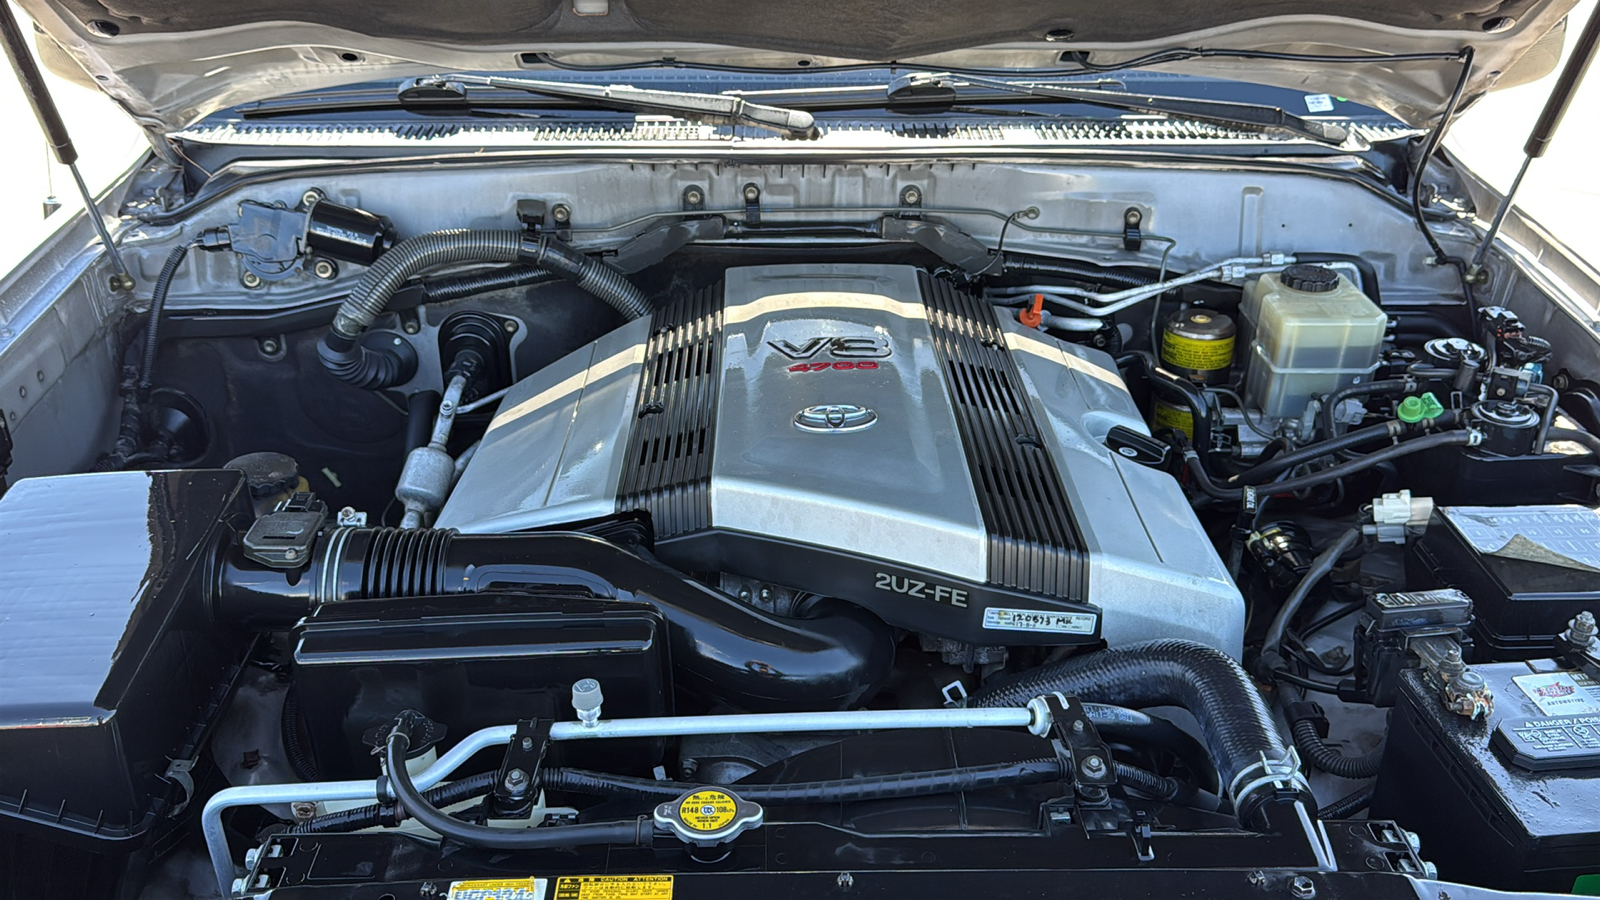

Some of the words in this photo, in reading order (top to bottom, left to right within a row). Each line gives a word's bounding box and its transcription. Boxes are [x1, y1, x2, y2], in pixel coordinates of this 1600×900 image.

[766, 336, 892, 359] V8
[788, 361, 879, 372] 4700
[875, 572, 968, 608] 2UZ-FE
[1547, 698, 1585, 706] AUTOMOTIVE
[1532, 719, 1571, 727] DANGER
